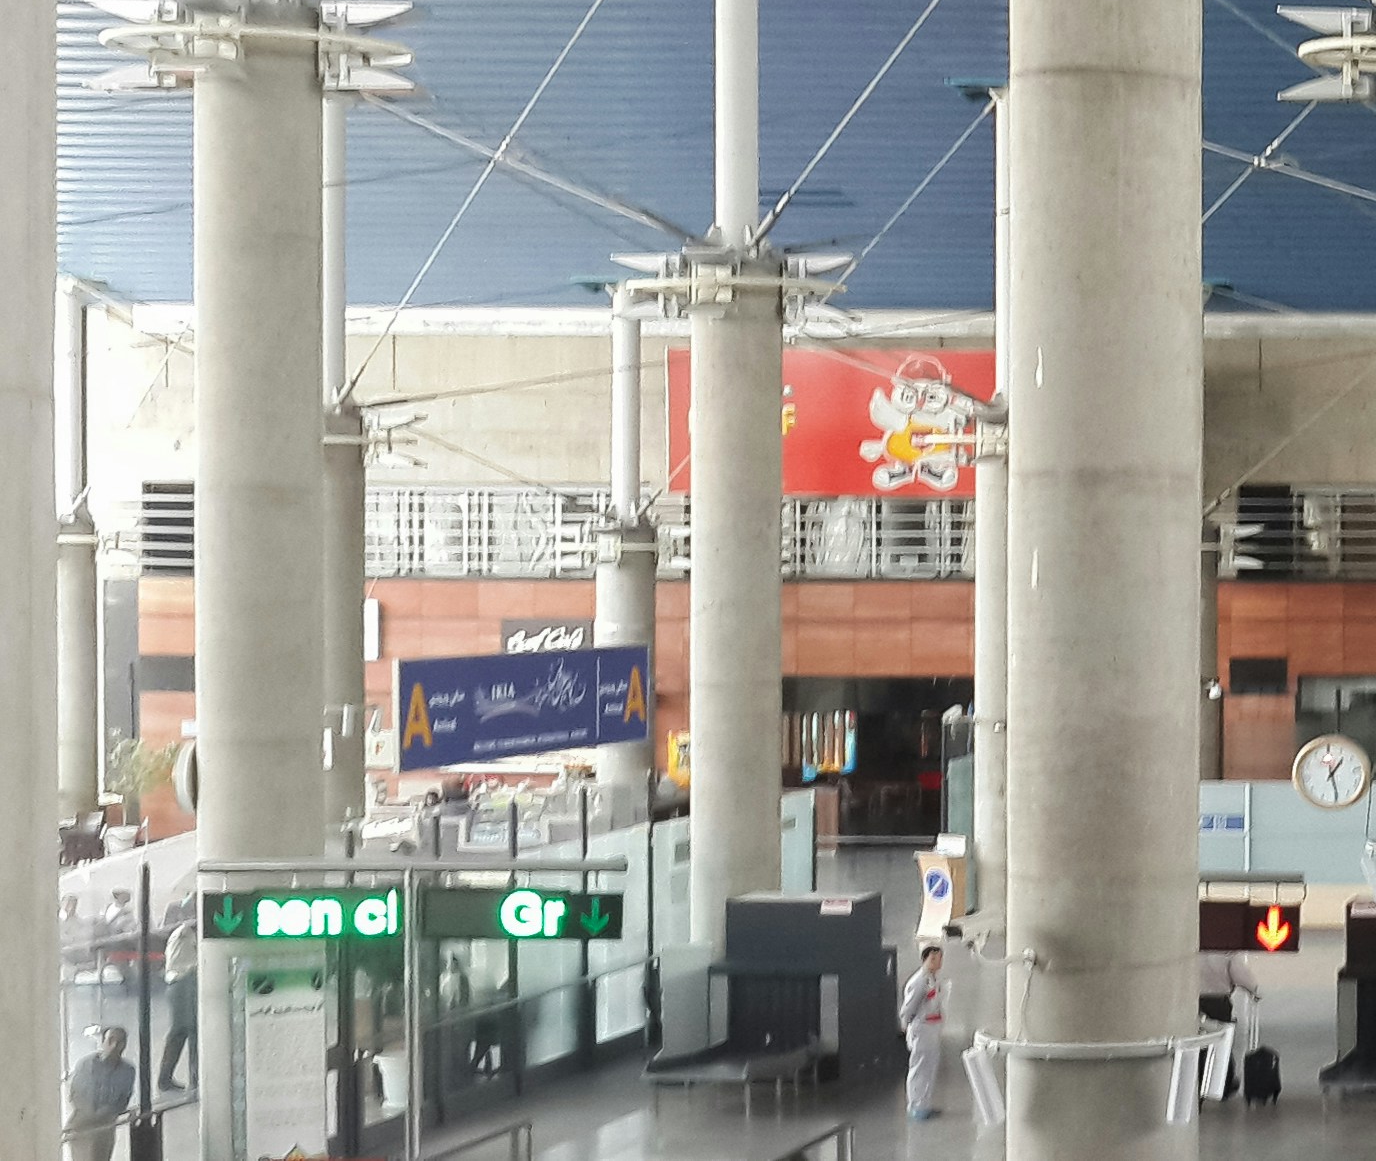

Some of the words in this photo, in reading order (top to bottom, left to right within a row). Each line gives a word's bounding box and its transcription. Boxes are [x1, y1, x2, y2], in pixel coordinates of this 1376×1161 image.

[402, 682, 434, 750] A
[624, 665, 647, 724] A
[499, 889, 567, 938] Gr
